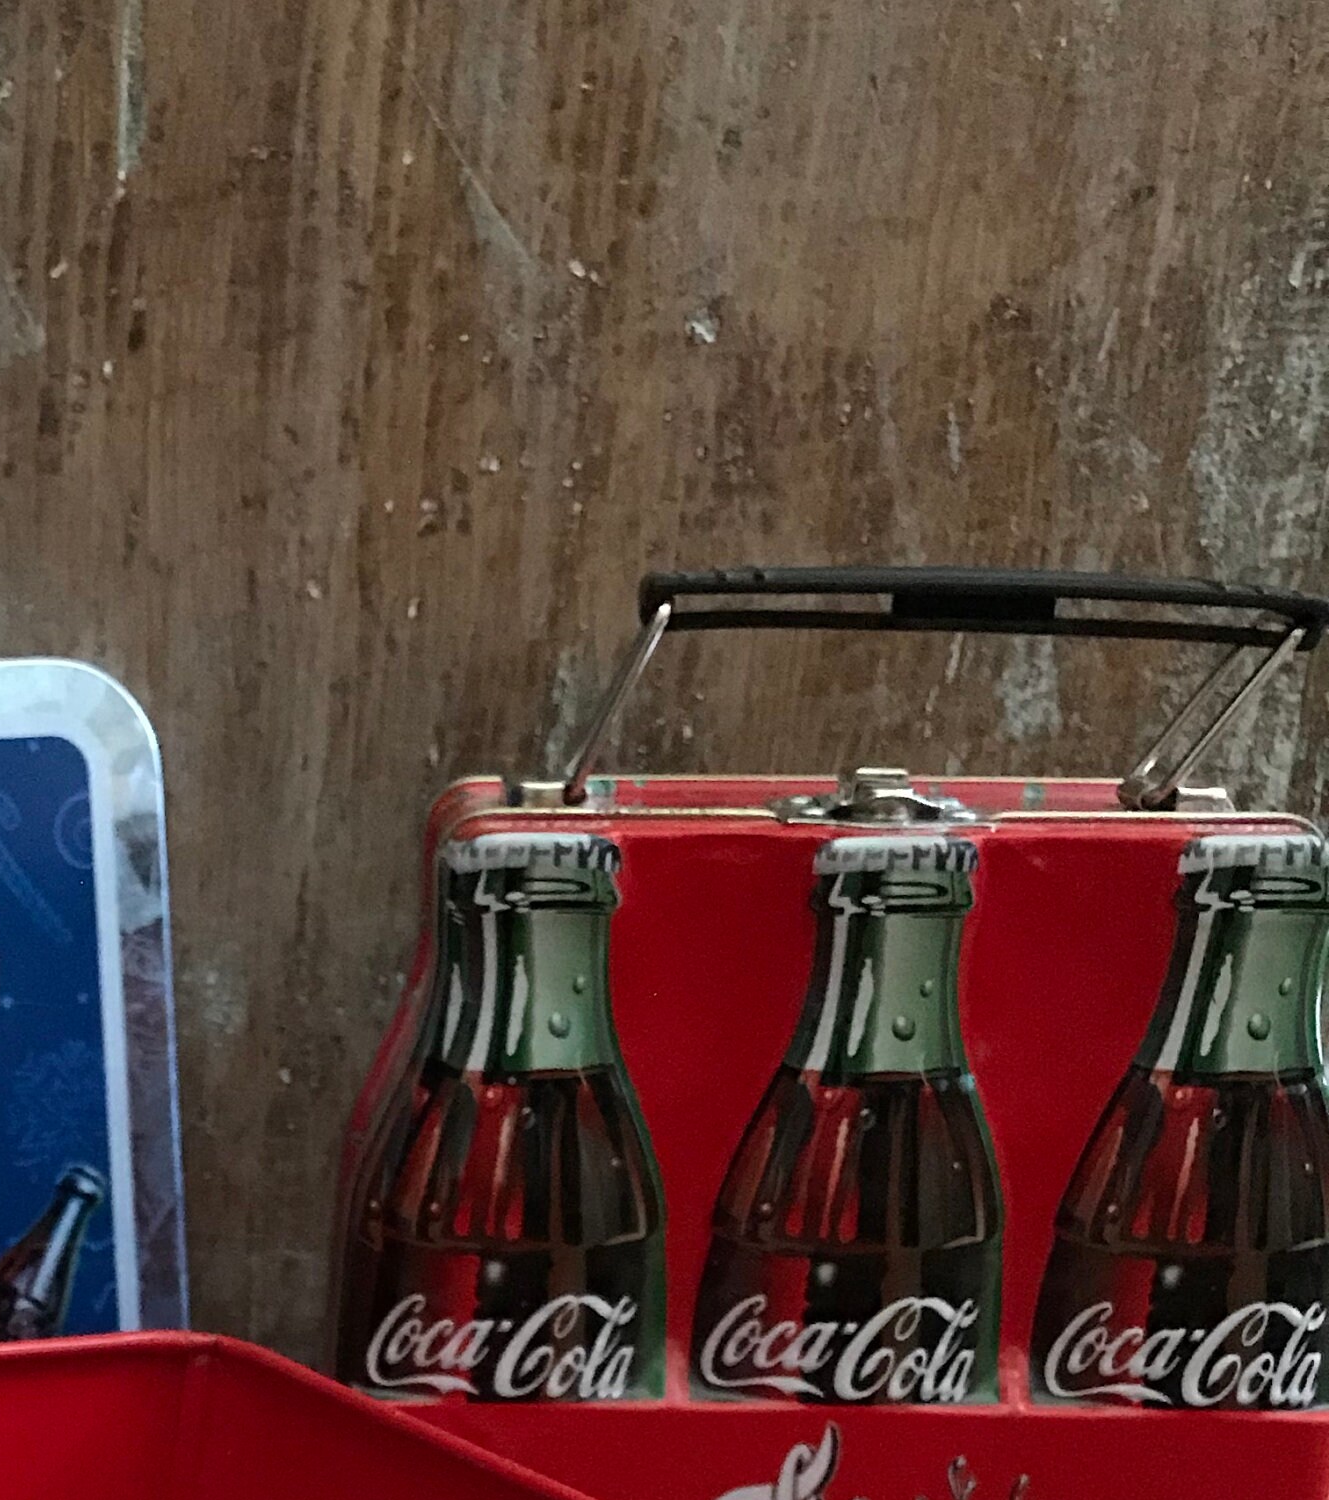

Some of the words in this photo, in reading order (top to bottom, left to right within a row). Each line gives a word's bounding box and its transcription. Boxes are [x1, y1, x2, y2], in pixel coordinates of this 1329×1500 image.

[365, 1292, 638, 1399] Coca-Cola
[699, 1292, 979, 1402] Coca-Cola
[1044, 1300, 1328, 1408] Coca-Cola
